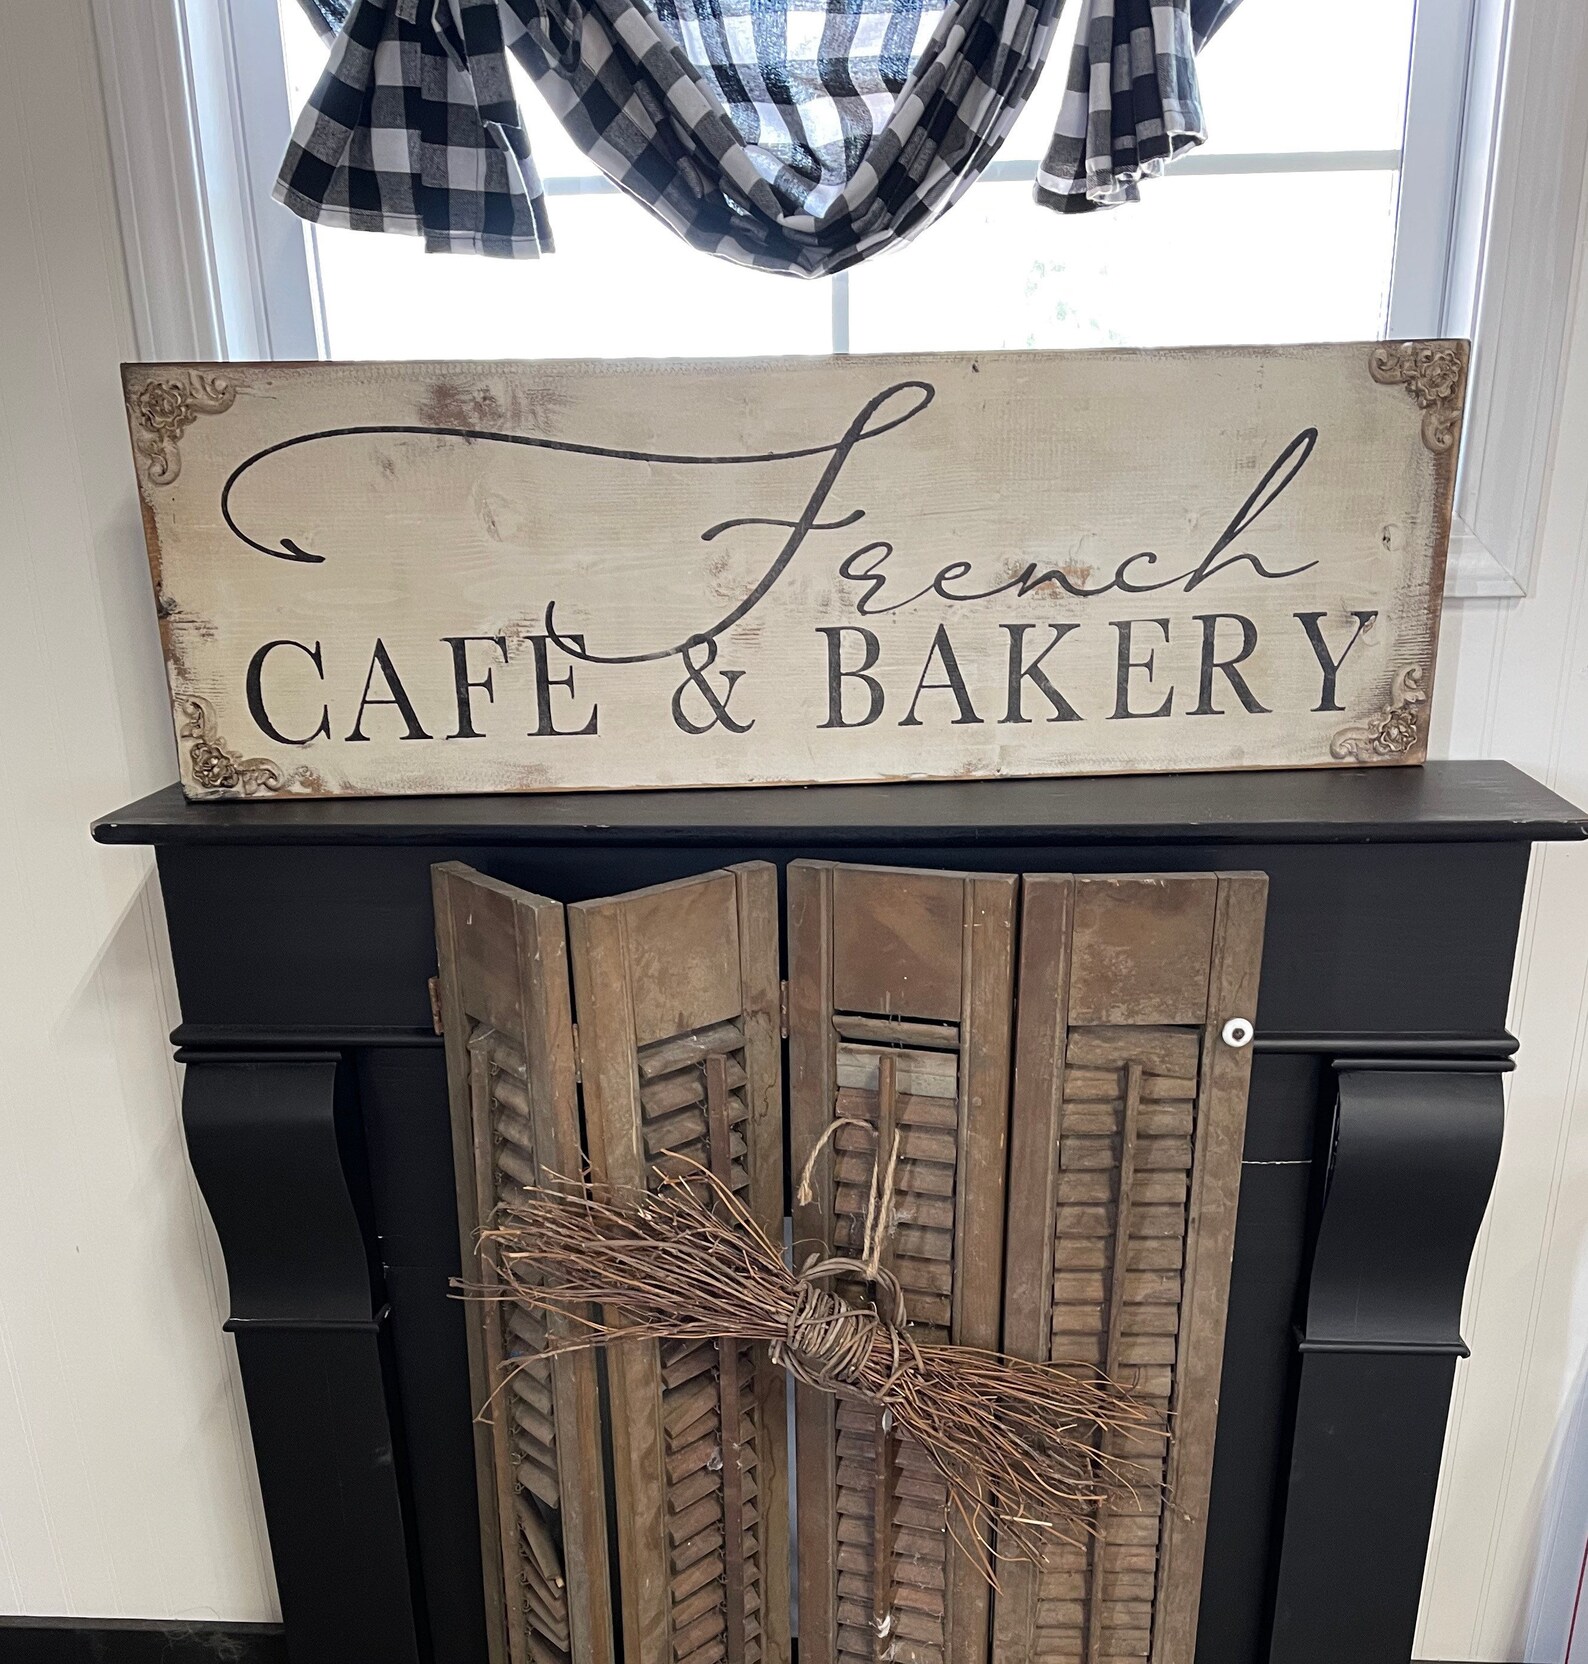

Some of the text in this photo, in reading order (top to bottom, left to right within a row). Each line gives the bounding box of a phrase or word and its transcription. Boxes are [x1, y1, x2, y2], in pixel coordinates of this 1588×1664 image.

[221, 380, 1320, 663] French
[671, 633, 756, 734] &
[815, 610, 1378, 729] BAKERY
